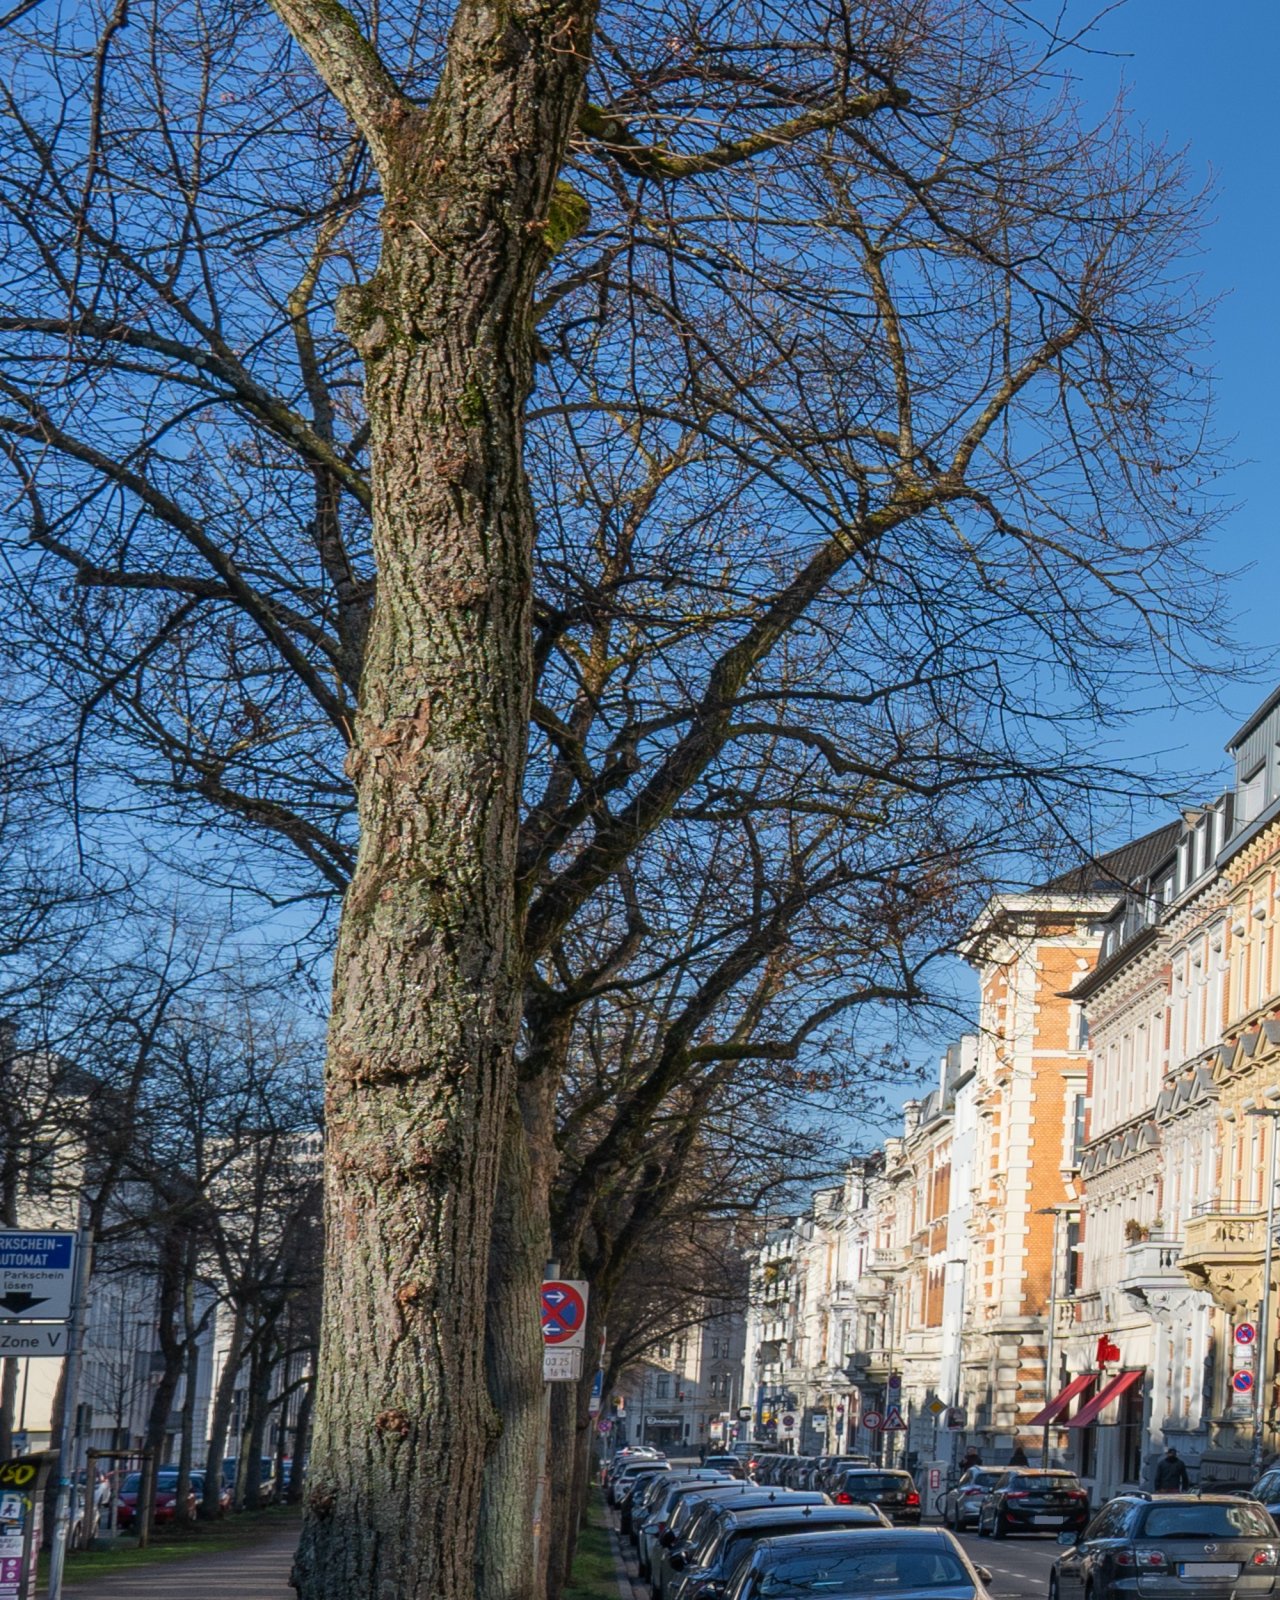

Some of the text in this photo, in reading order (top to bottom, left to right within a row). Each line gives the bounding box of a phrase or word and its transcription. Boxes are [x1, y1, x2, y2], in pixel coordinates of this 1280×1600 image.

[0, 1253, 49, 1266] UTOMAT
[4, 1271, 64, 1280] Parkschein
[4, 1282, 34, 1290] lösen
[1, 1332, 61, 1348] Zone V
